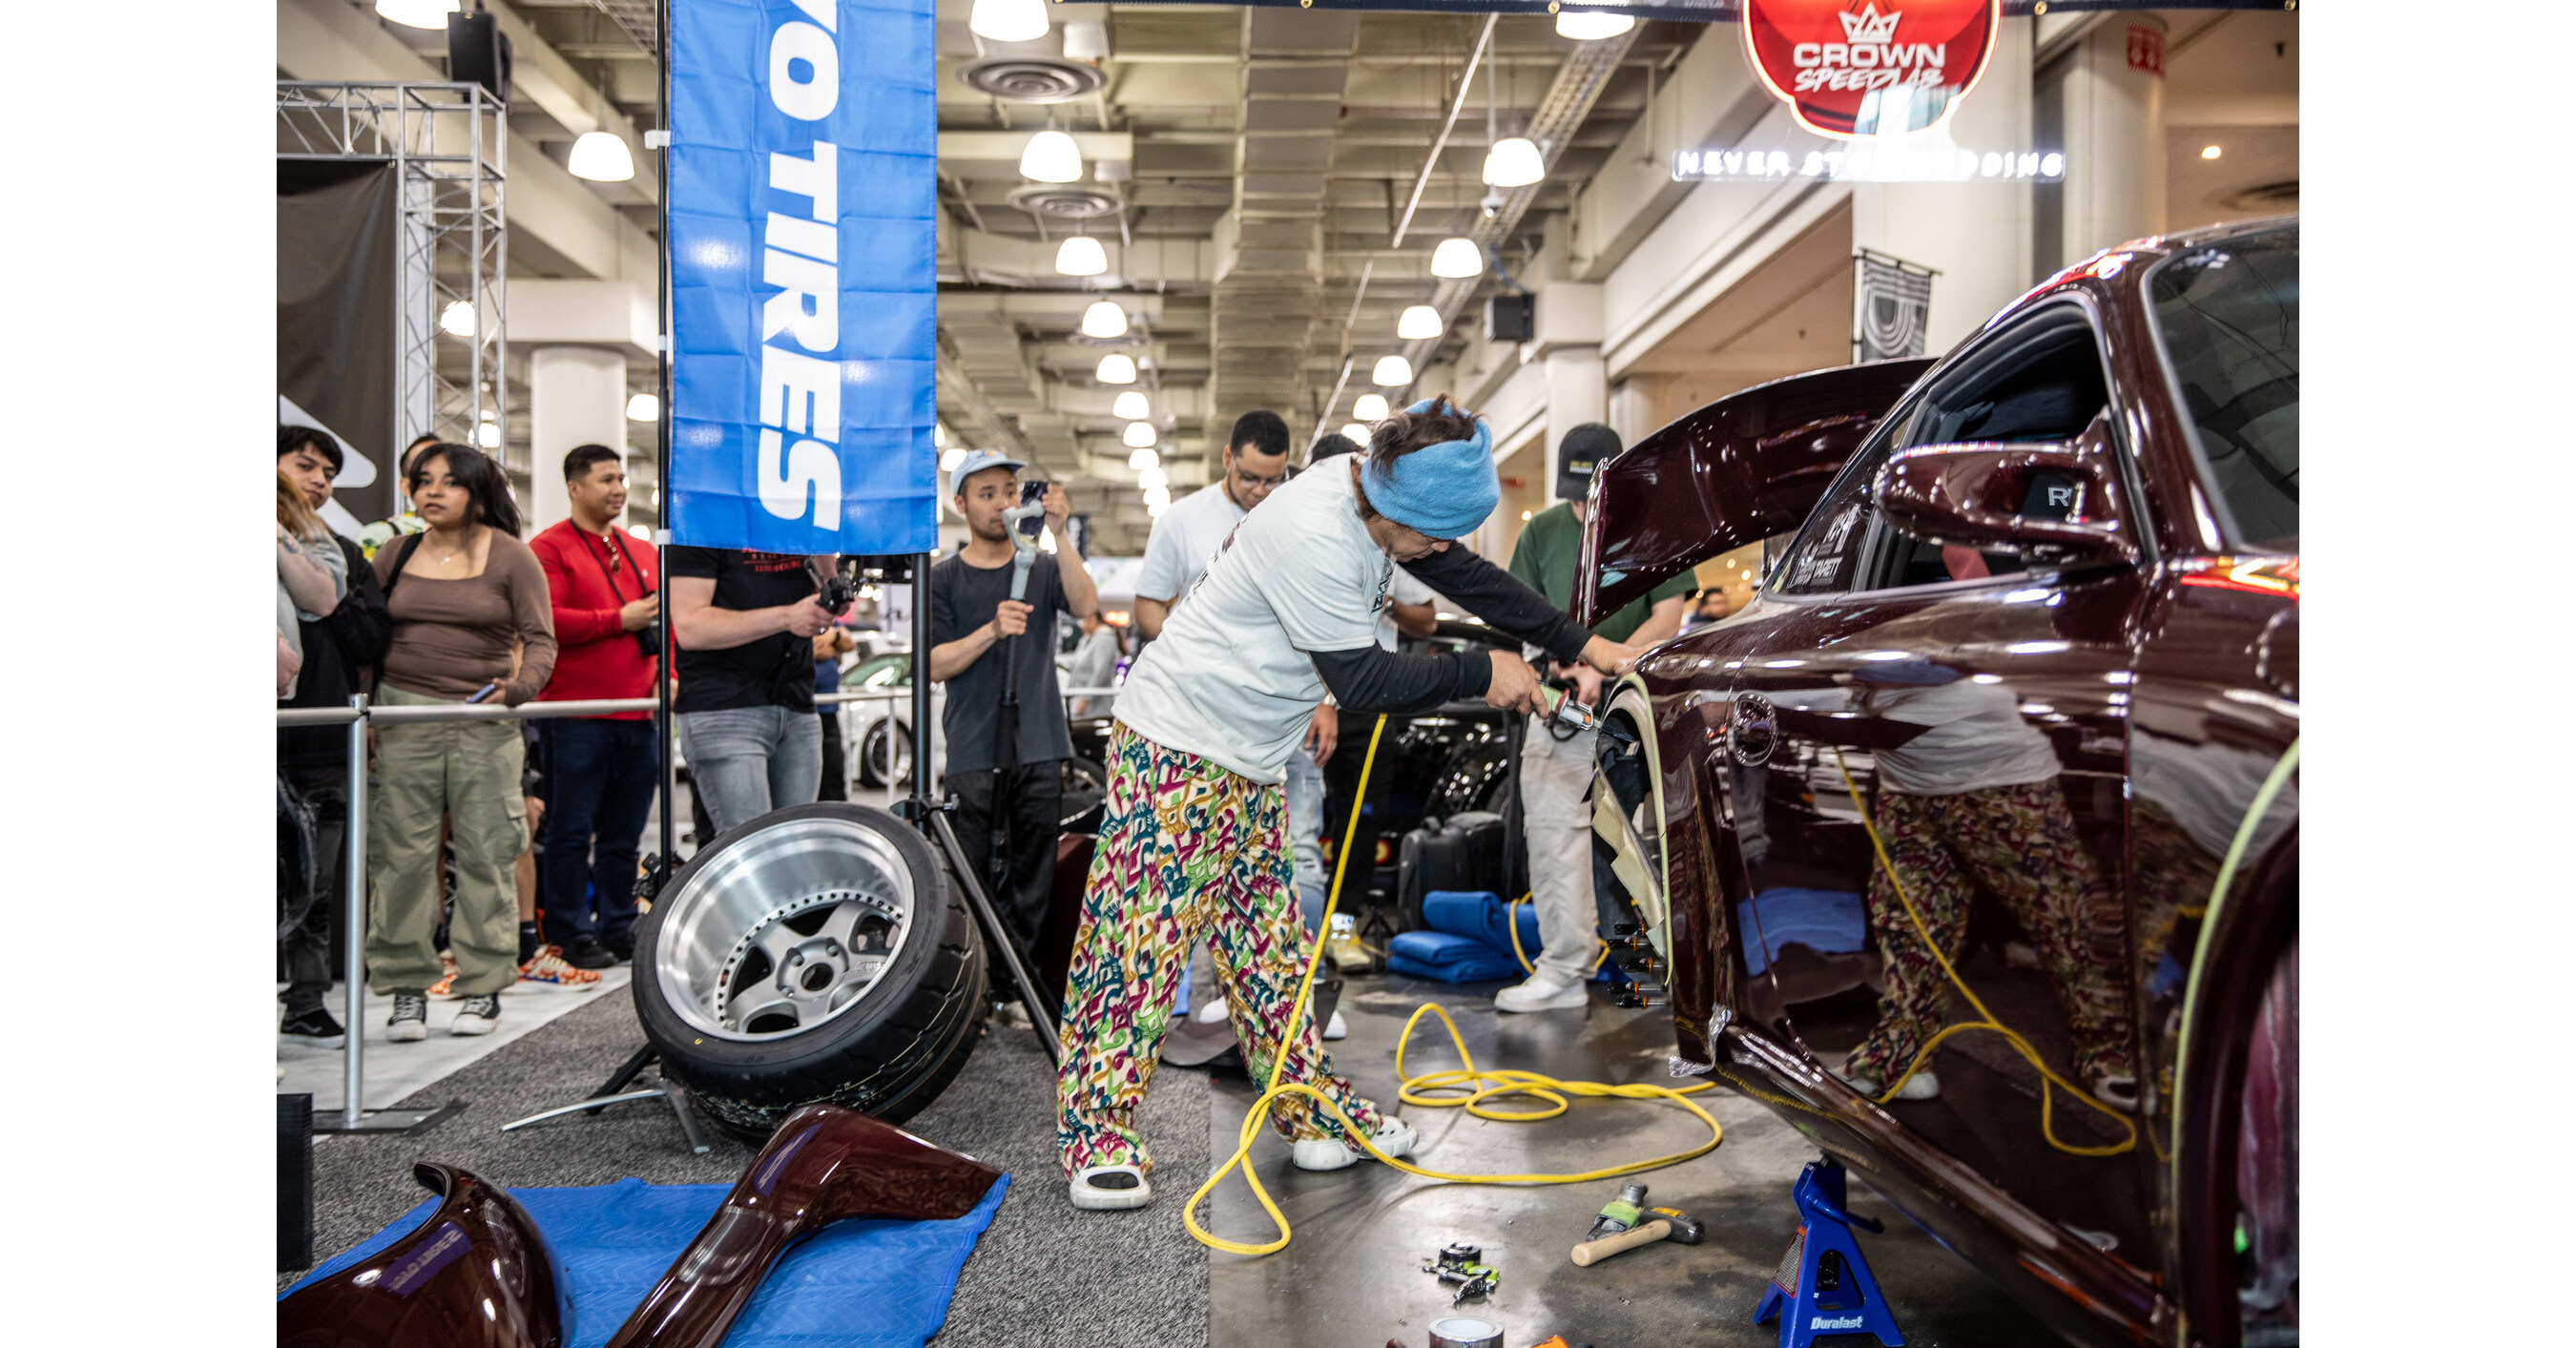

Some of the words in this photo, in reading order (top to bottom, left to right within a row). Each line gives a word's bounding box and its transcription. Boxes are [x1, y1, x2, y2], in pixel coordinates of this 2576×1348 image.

[1793, 43, 1945, 68] CROWN
[1679, 151, 1791, 178] NEVER
[1800, 151, 1888, 178] STO
[758, 139, 841, 532] TIRES
[1810, 1315, 1863, 1330] Duralast
